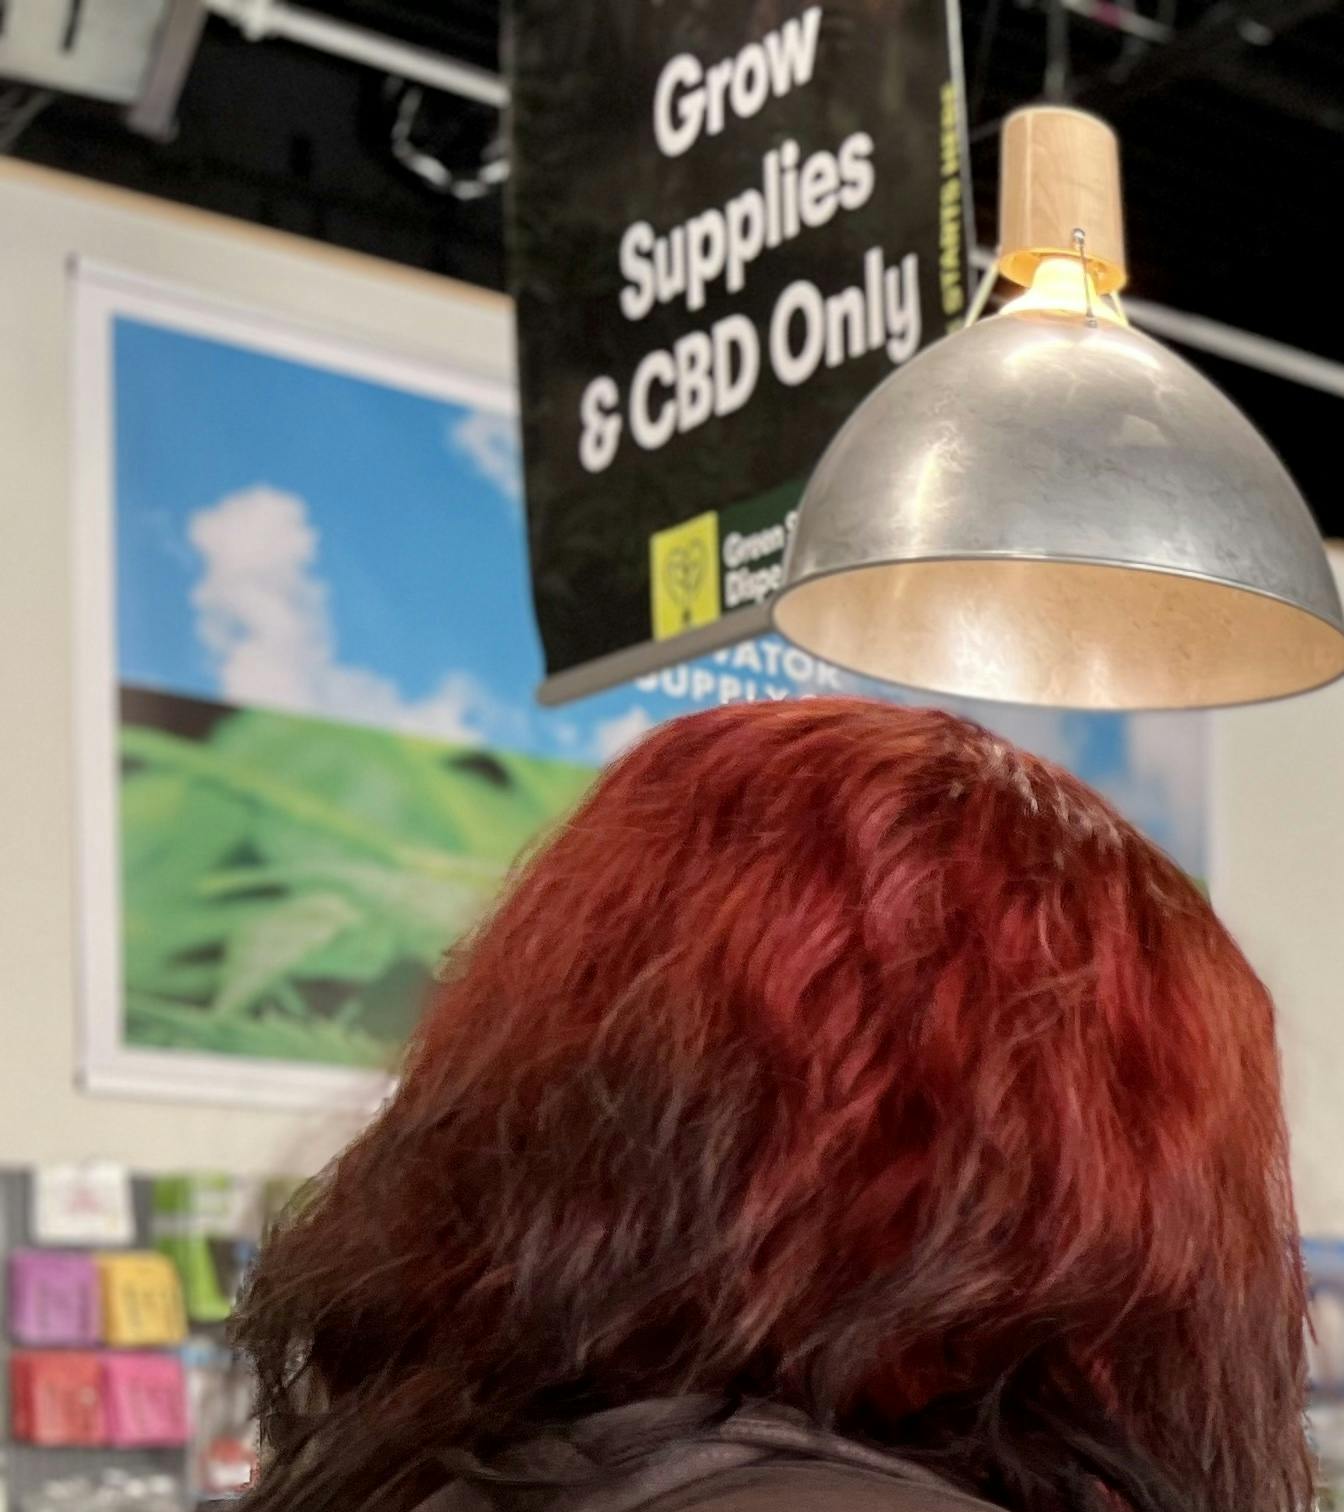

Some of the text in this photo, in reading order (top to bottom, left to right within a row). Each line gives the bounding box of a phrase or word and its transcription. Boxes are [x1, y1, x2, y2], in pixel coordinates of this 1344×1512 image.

[653, 5, 822, 157] Grow
[619, 132, 875, 320] Supplies
[579, 246, 922, 473] & CBD Only
[723, 525, 784, 568] Green
